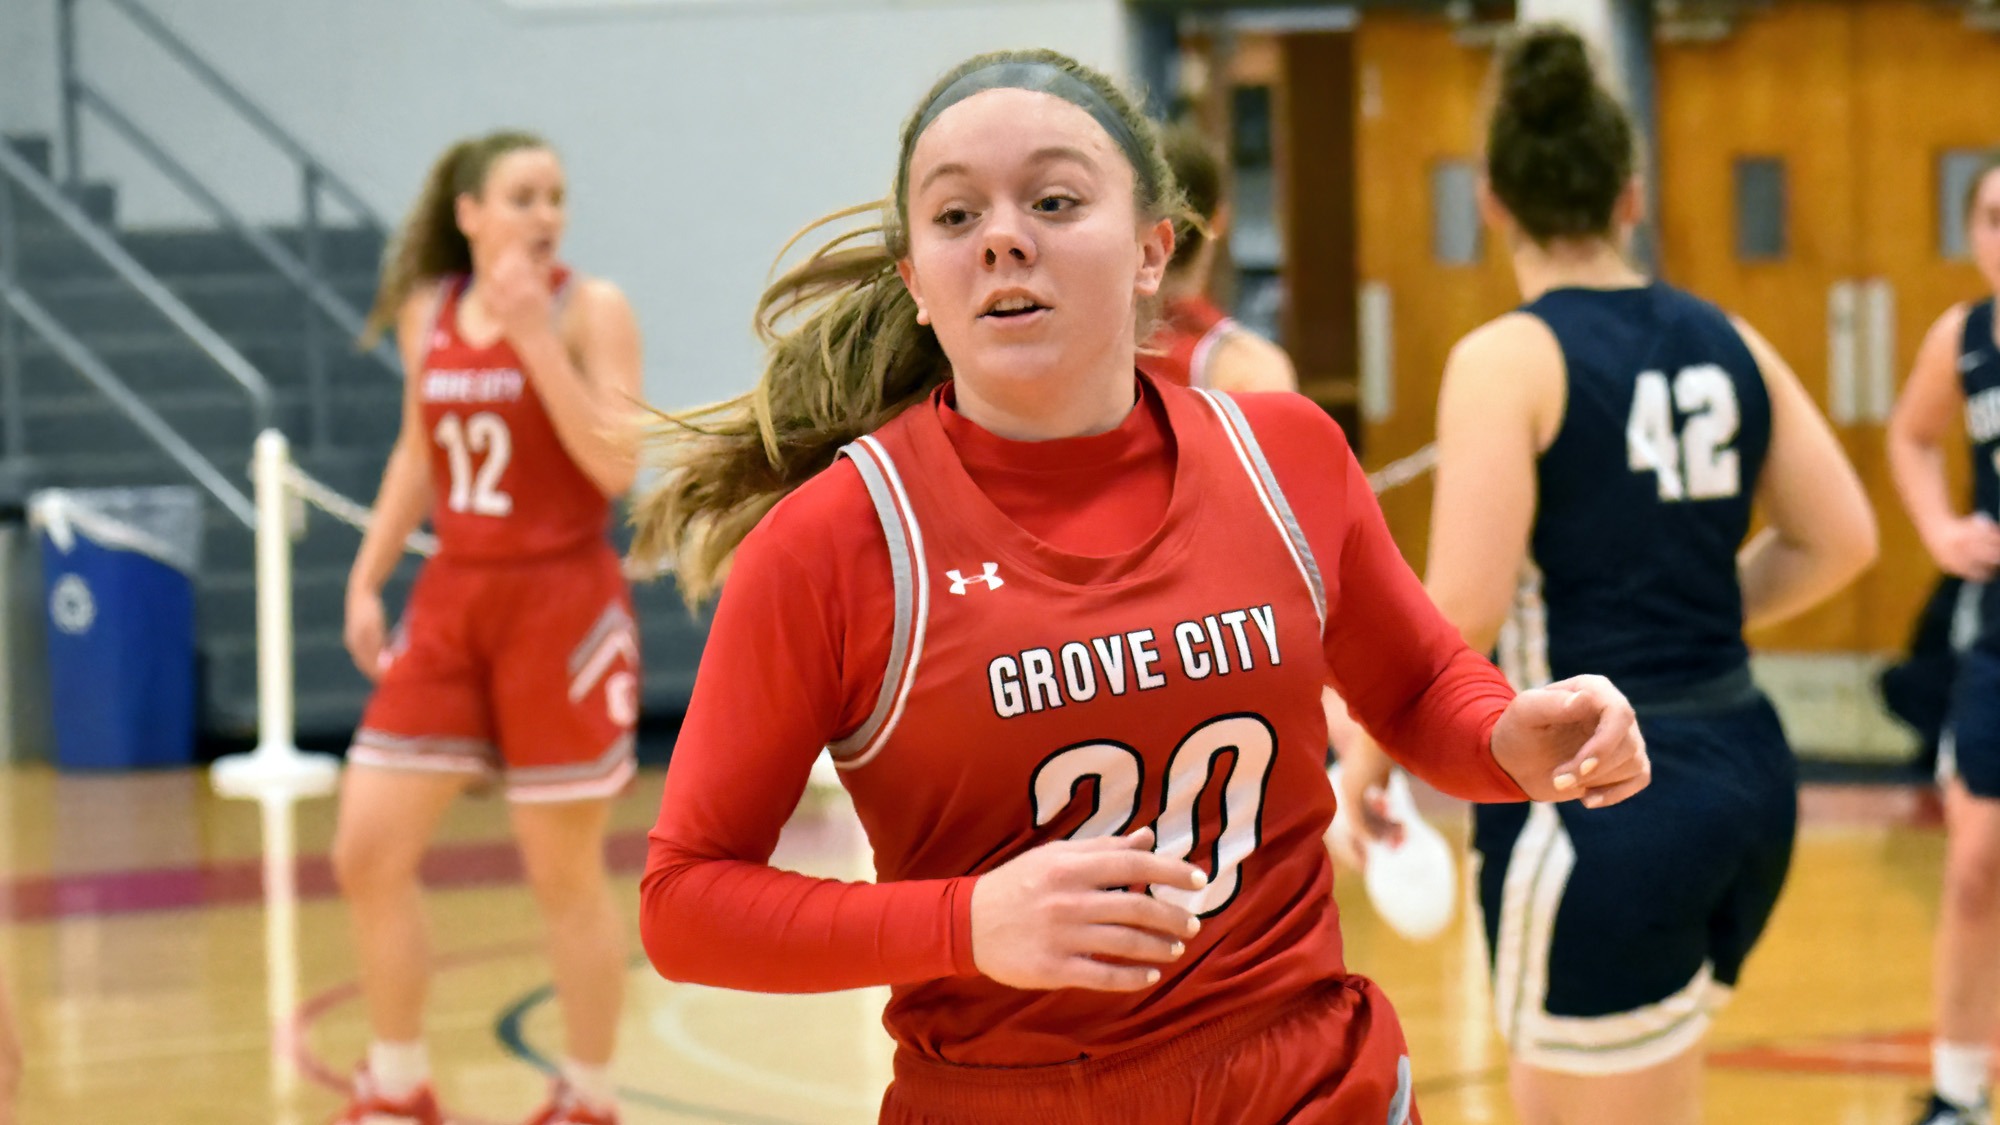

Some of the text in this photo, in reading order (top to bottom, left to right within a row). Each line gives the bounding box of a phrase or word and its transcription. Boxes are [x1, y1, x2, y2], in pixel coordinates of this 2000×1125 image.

[435, 411, 513, 517] 12
[1626, 362, 1741, 502] 42
[987, 604, 1282, 719] GROVE CITY
[1029, 711, 1278, 918] 20
